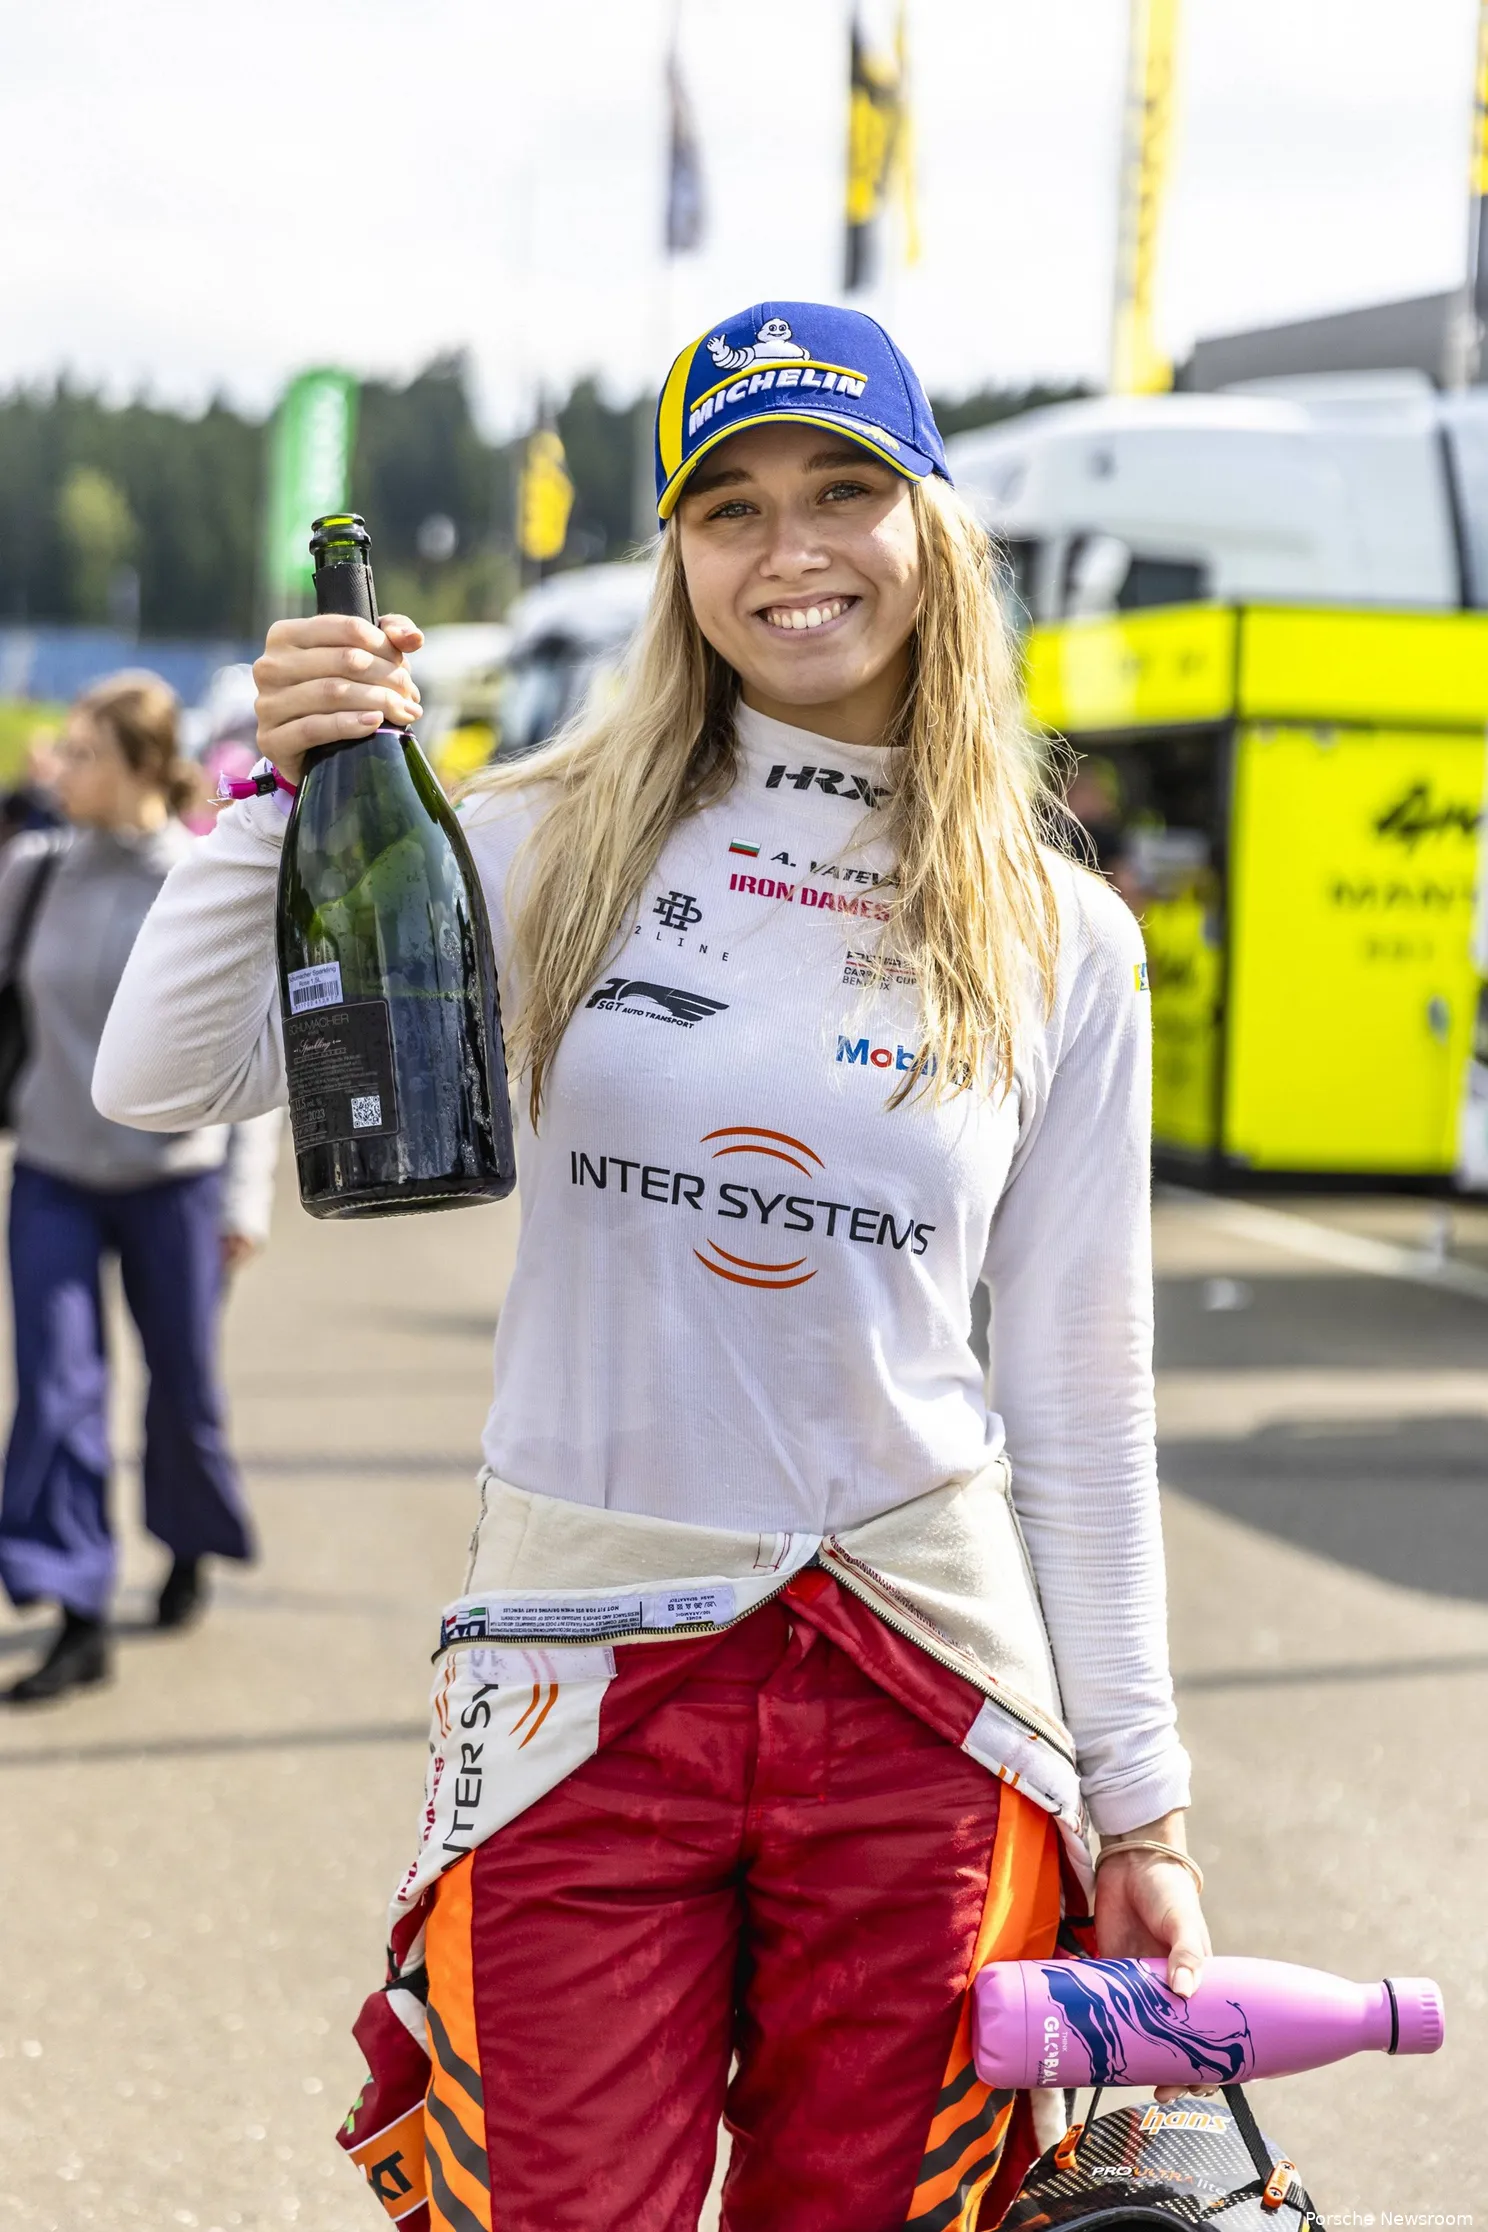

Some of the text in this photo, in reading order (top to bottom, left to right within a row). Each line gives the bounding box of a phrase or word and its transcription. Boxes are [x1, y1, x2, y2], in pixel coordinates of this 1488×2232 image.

[689, 368, 866, 437] MICHELIN
[765, 765, 893, 810] HRX
[771, 851, 796, 867] A.
[729, 874, 890, 921] IRON DAMES
[597, 1000, 695, 1029] SGT AUTO TRANSPORT
[571, 1151, 936, 1256] INTER SYSTEMS
[1043, 2016, 1060, 2085] GLOBAL
[1139, 2105, 1232, 2135] hans
[1091, 2165, 1227, 2196] PRO ULTRA lite
